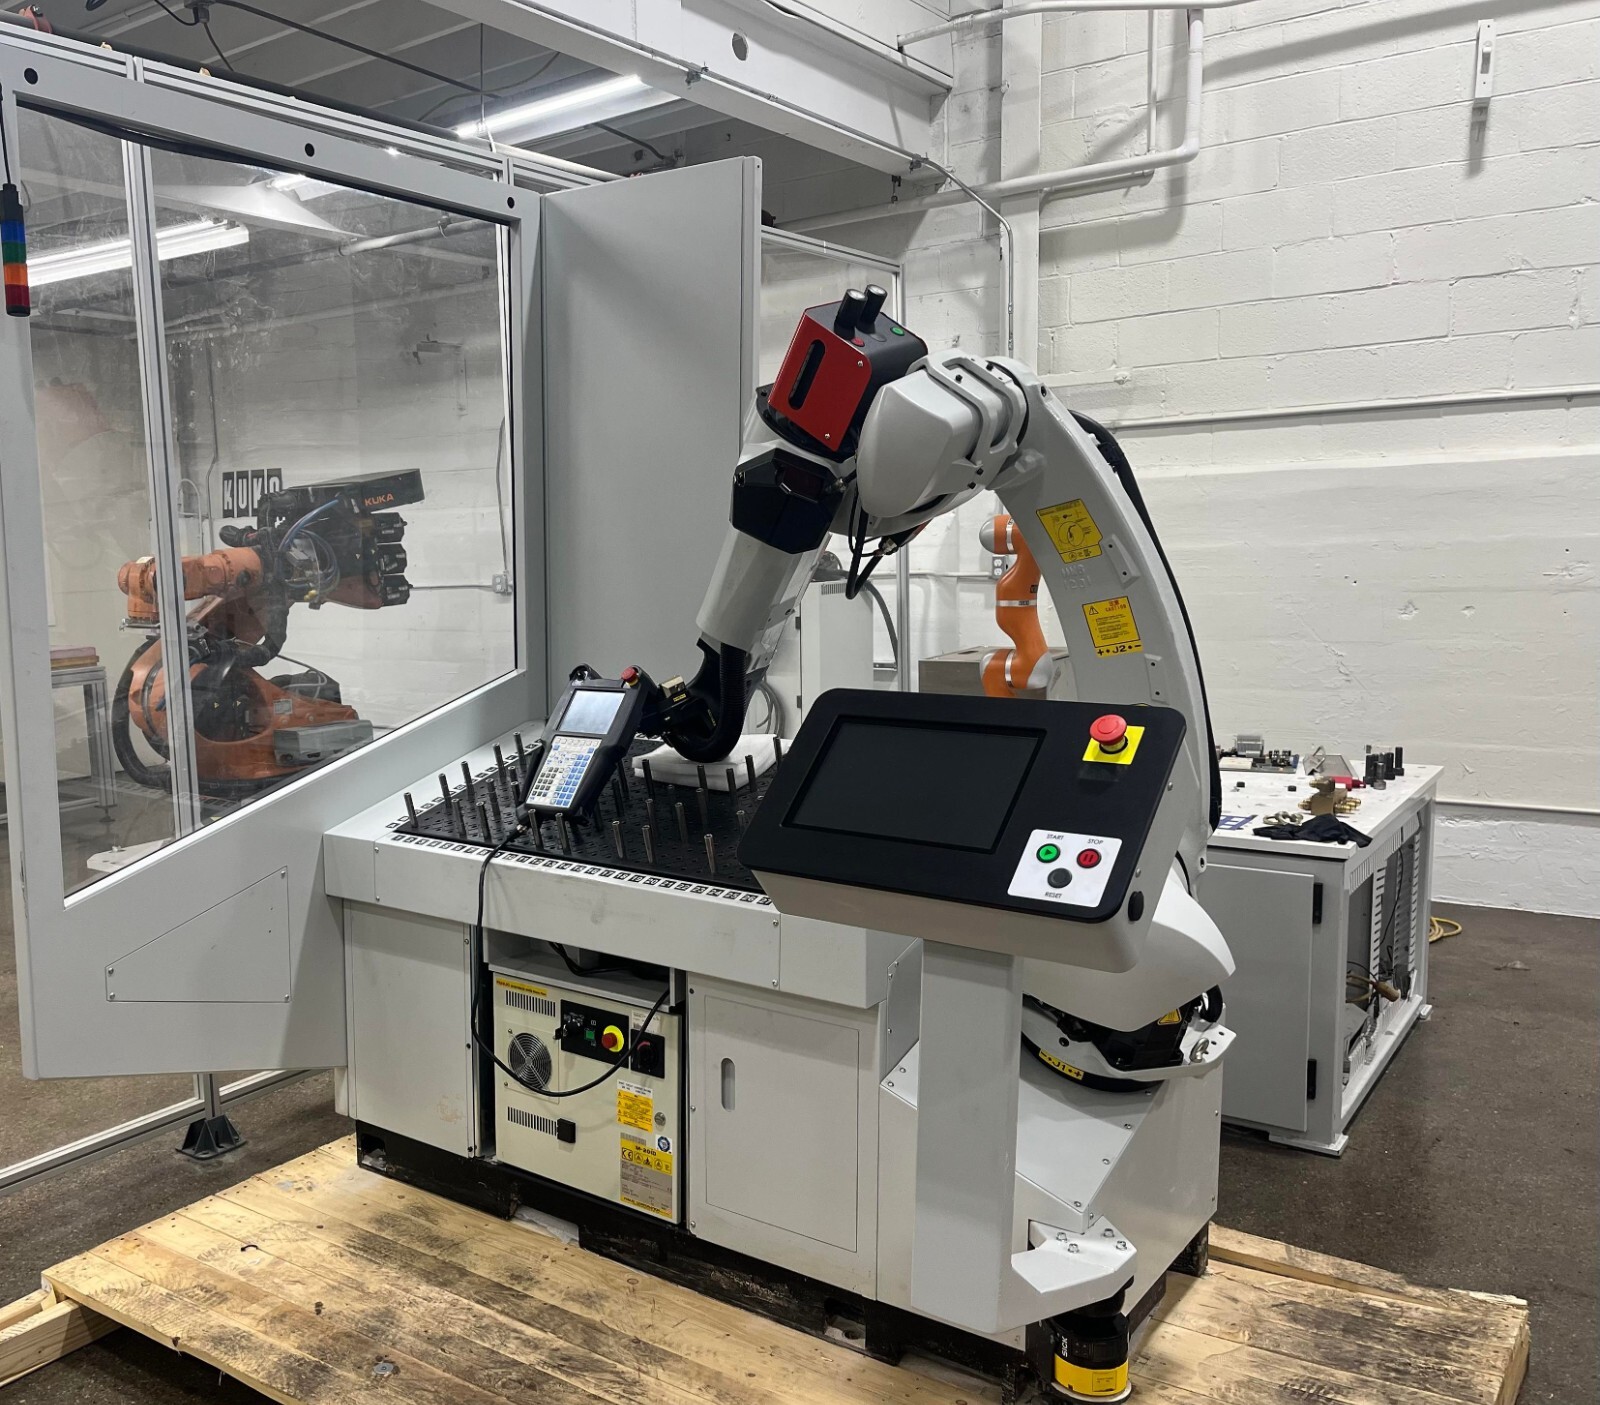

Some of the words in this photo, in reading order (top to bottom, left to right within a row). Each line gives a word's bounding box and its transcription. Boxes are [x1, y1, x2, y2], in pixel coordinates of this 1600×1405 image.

[364, 493, 394, 506] KUKA
[1112, 645, 1127, 653] J2
[644, 877, 659, 885] 20
[661, 880, 675, 888] 21
[676, 883, 690, 891] 22
[692, 886, 706, 894] 23
[708, 888, 723, 896] 24
